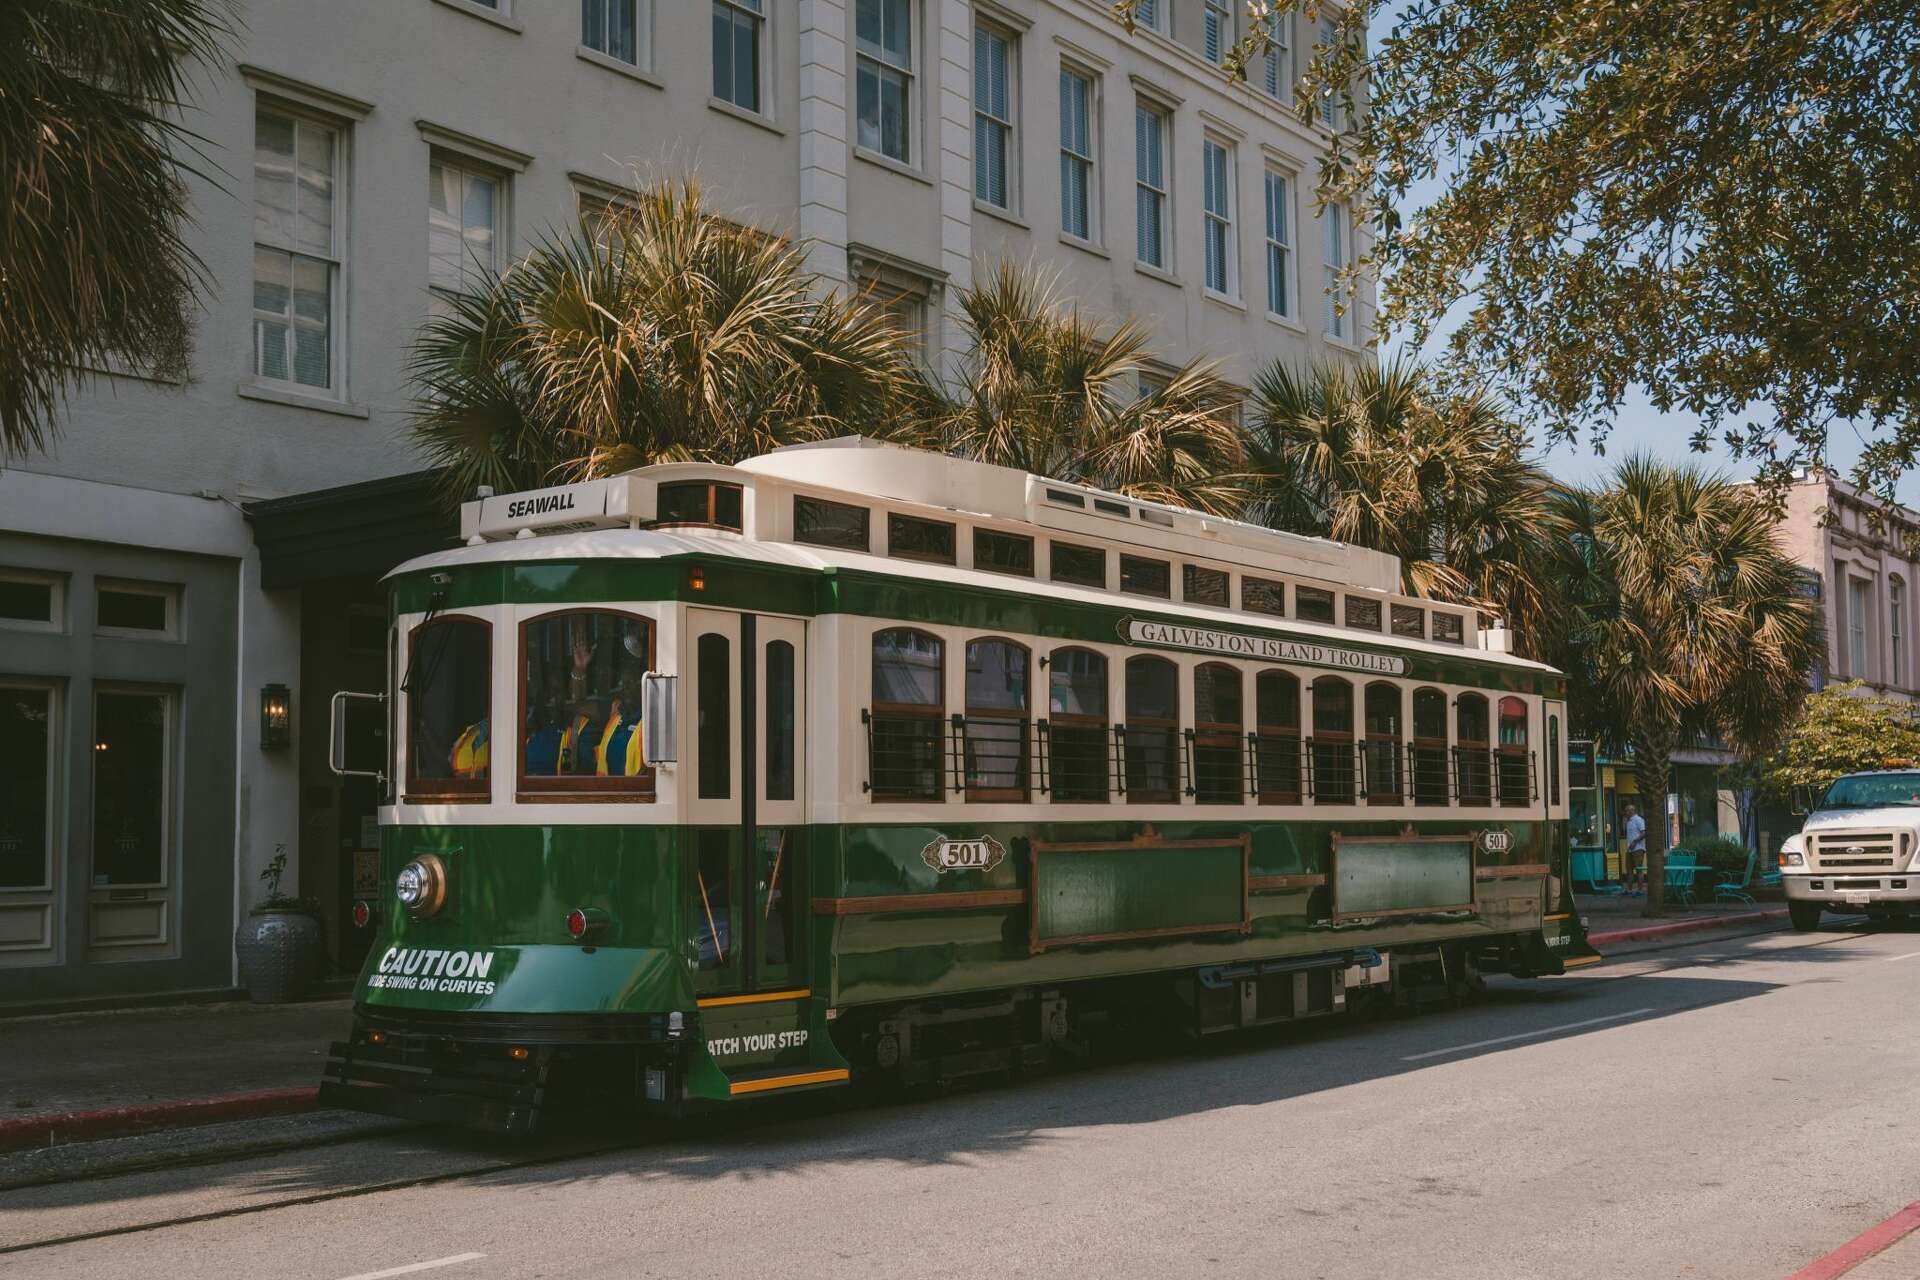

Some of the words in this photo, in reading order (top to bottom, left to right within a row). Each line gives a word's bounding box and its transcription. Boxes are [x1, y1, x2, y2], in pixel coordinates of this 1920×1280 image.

[507, 493, 575, 518] SEAWALL
[1141, 624, 1255, 653] GALVESTON
[1262, 641, 1323, 661] ISLAND
[1327, 650, 1396, 672] TROLLEY
[947, 843, 982, 865] 501
[1489, 834, 1505, 849] 501
[379, 947, 494, 978] CAUTION
[367, 974, 387, 988] WIDE
[386, 977, 417, 989] SWING
[419, 978, 437, 990] ON
[439, 979, 495, 994] CURVES
[707, 1037, 739, 1056] ATCH
[743, 1033, 776, 1052] YOUR
[779, 1030, 808, 1048] STEP
